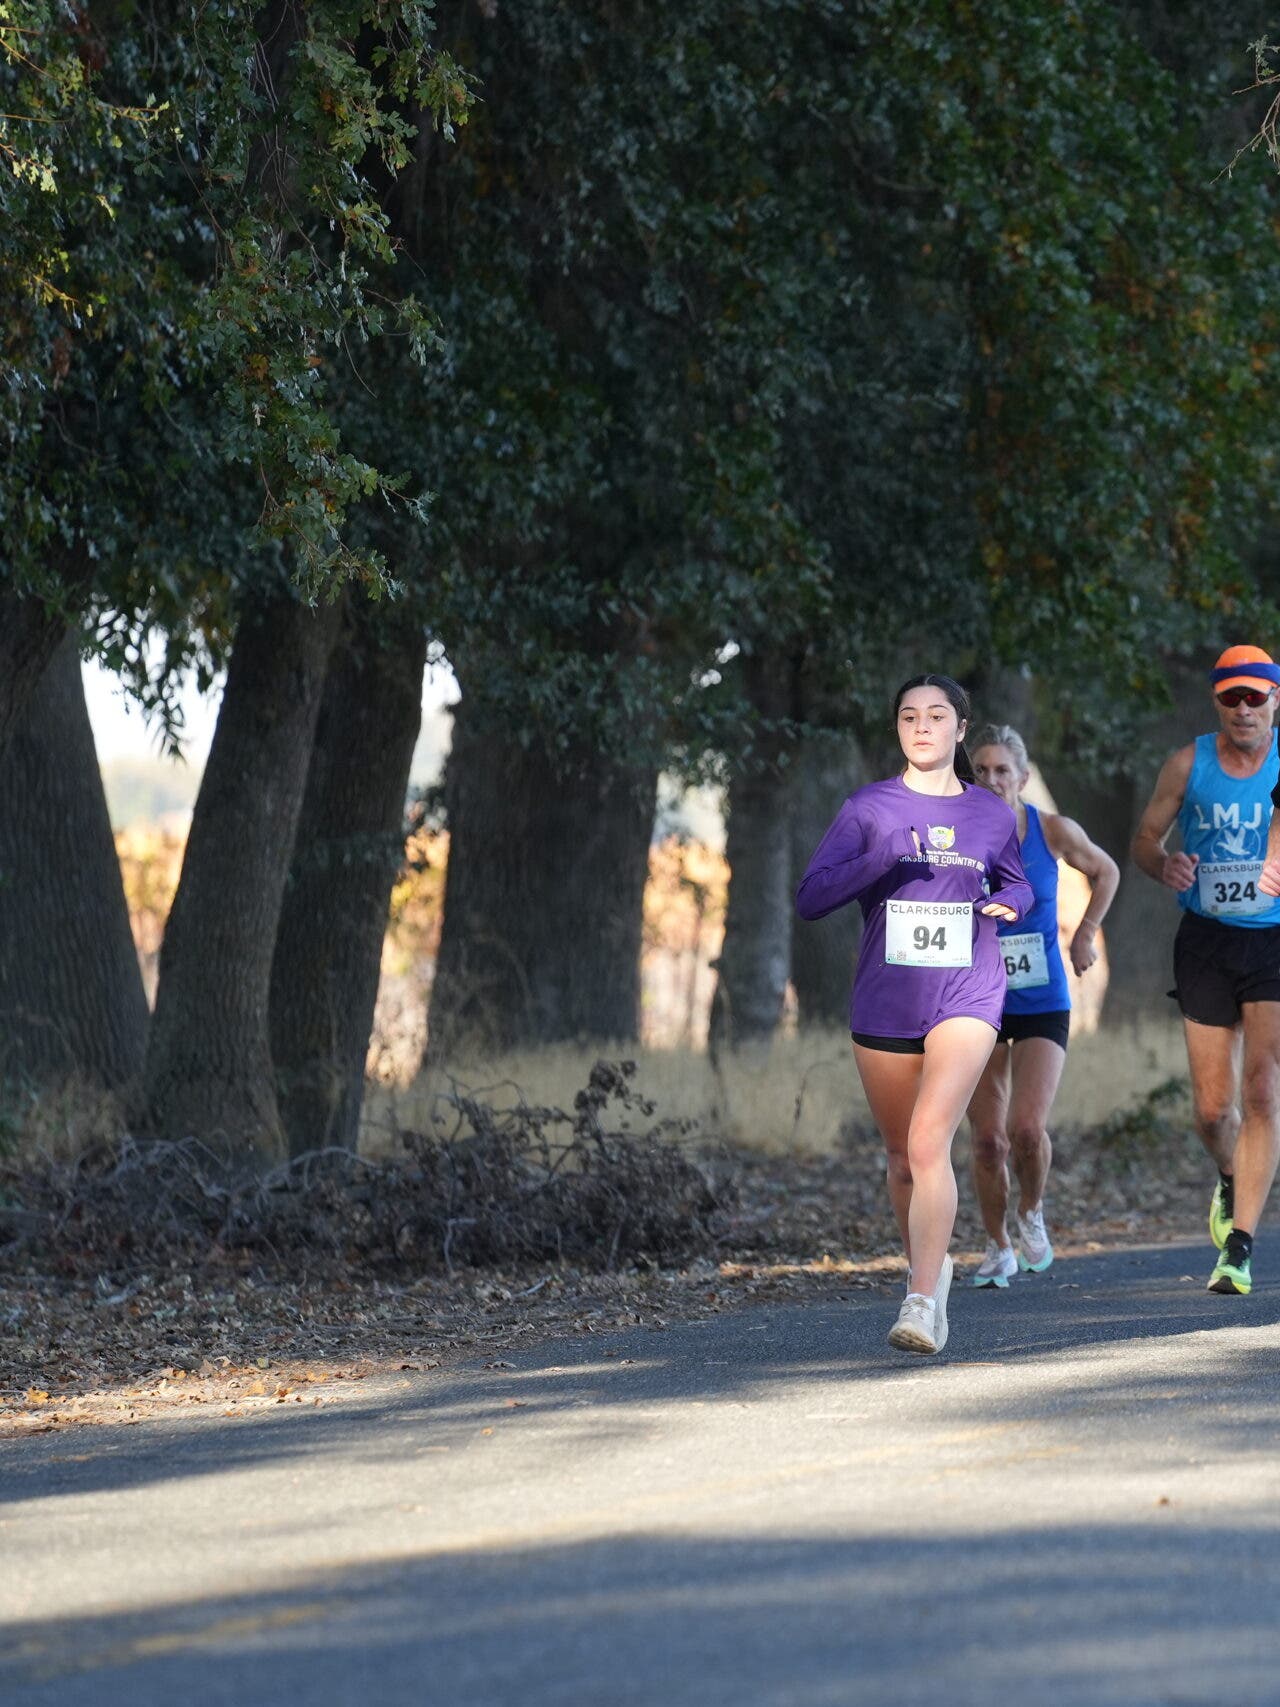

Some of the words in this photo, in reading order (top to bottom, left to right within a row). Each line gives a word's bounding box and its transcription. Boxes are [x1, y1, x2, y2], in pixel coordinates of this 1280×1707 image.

[1194, 803, 1275, 829] LMJ
[941, 855, 976, 868] COUNTRY
[1201, 863, 1265, 873] CLARKSBUR
[1214, 881, 1257, 903] 324
[890, 903, 970, 916] CLARKSBURG
[913, 925, 947, 951] 94
